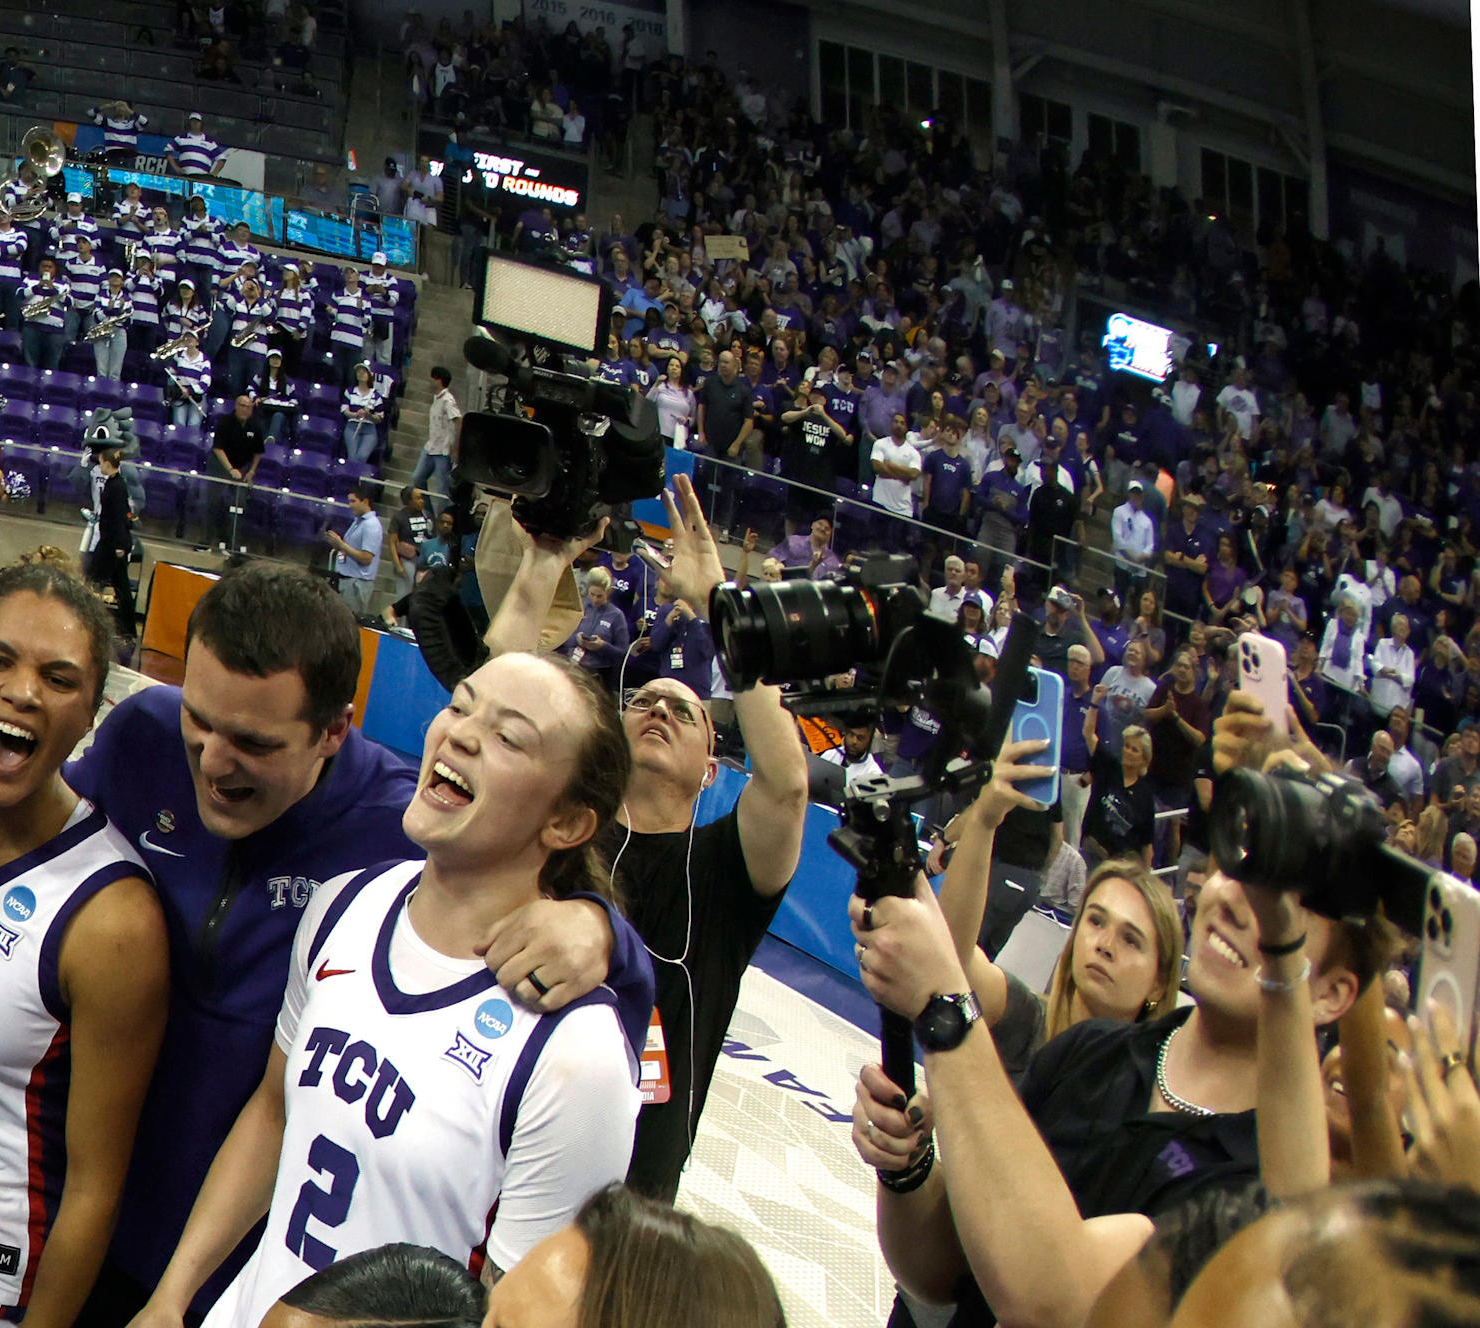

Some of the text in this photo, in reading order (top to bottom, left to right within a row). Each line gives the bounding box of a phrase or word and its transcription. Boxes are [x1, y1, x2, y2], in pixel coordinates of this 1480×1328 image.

[135, 155, 168, 175] RCH
[502, 176, 579, 207] ROUNDS
[832, 398, 854, 414] TCU
[805, 433, 826, 448] WON
[5, 895, 32, 920] NCAA
[477, 1011, 507, 1033] NCAA
[298, 1026, 417, 1140] TCU
[284, 1133, 361, 1273] 2
[0, 1253, 12, 1267] M
